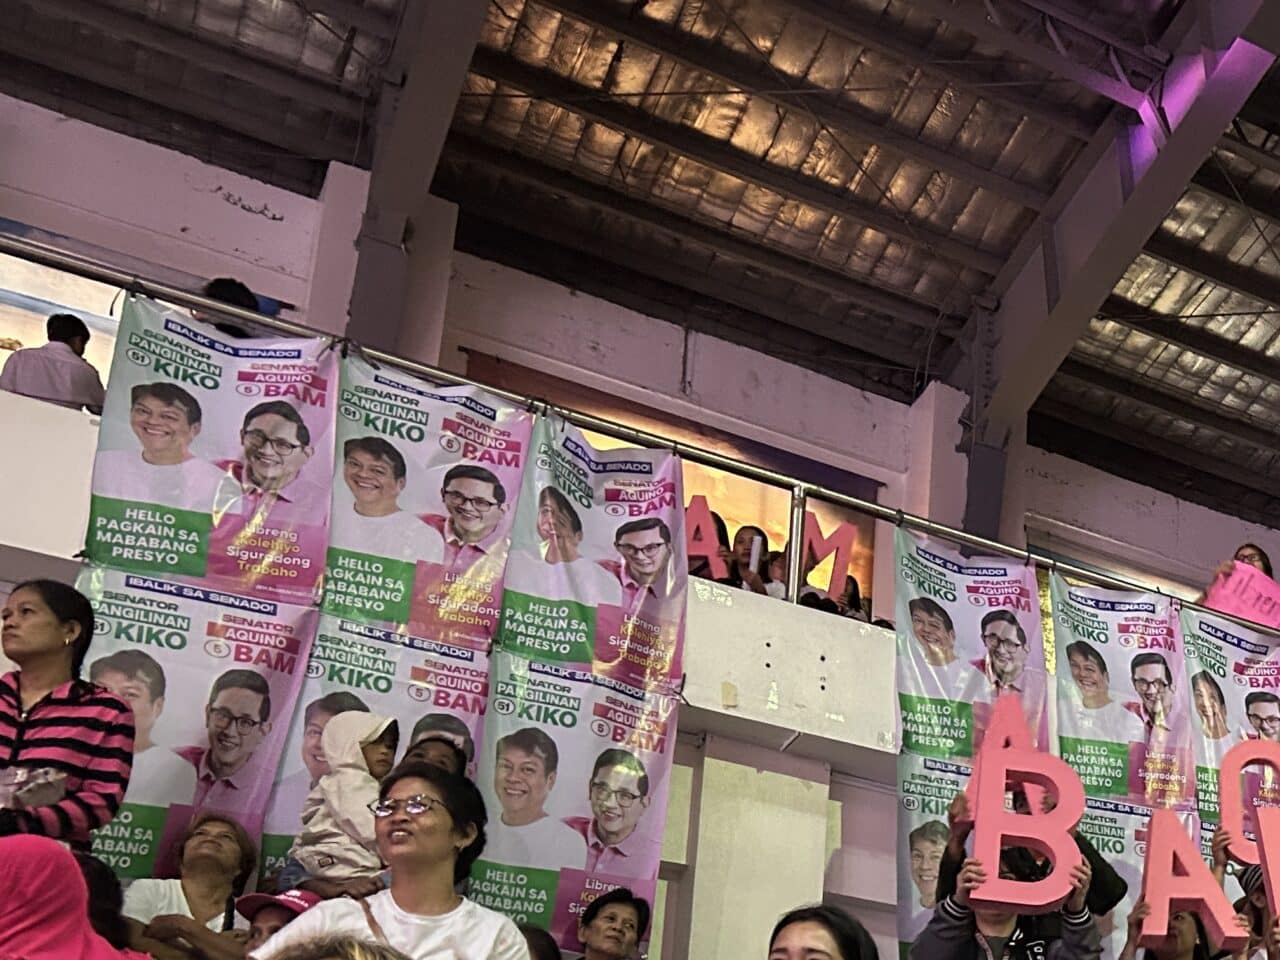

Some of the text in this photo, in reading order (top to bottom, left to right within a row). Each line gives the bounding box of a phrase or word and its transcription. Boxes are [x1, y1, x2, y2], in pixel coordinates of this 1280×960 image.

[143, 329, 211, 361] SENATOR
[167, 321, 299, 359] IBALIK SA SENADO!
[129, 335, 221, 376] PANGILINAN
[135, 351, 221, 390] 51 KIKO
[250, 363, 318, 373] SENATOR
[255, 373, 312, 383] AQUINO
[263, 384, 326, 408] BAM
[354, 385, 420, 407] SENATOR
[342, 390, 429, 425] PANGILINAN
[345, 406, 425, 443] 51 KIKO
[455, 411, 512, 438] SENATOR
[456, 424, 506, 449] AQUINO
[462, 443, 520, 468] BAM
[619, 487, 664, 501] AQUINO
[125, 507, 176, 524] HELLO
[628, 496, 677, 517] BAM
[96, 516, 200, 541] PAGKAIN SA
[95, 531, 198, 554] MABABANG
[112, 546, 178, 564] PRESYO
[226, 546, 311, 568] Siguradong
[338, 556, 384, 574] HELLO
[237, 560, 298, 578] Trabaho
[325, 564, 405, 590] AGKAIN SA
[103, 591, 179, 611] SENATOR
[128, 577, 275, 613] IBALIK SA SENADO!
[325, 580, 401, 602] ABABANG
[917, 579, 957, 602] KIKO
[979, 587, 1021, 595] AQUINO
[529, 603, 569, 617] HELLO
[988, 596, 1032, 612] BAM
[222, 614, 295, 633] SENATOR
[505, 608, 588, 631] PAGKAIN SA
[114, 621, 187, 650] KIKO
[225, 629, 287, 647] AQUINO
[343, 622, 385, 639] IBALIK
[413, 638, 472, 658] SENADO!
[504, 621, 587, 642] MABABANG
[1072, 622, 1109, 644] KIKO
[1128, 625, 1166, 636] AQUINO
[318, 634, 386, 657] SENATOR
[516, 635, 570, 654] PRESYO
[1136, 635, 1177, 652] BAM
[234, 646, 296, 675] BAM
[424, 659, 488, 680] SENATOR
[328, 664, 393, 693] KIKO
[426, 675, 482, 692] AQUINO
[499, 702, 577, 728] 51 KIKO
[917, 703, 952, 714] HELLO
[953, 717, 967, 728] SA
[612, 727, 665, 754] BAM
[912, 735, 955, 748] PRESYO
[1077, 745, 1108, 755] HELLO
[1109, 757, 1123, 767] SA
[135, 827, 153, 840] SA
[486, 868, 528, 885] HELLO
[529, 888, 547, 901] SA
